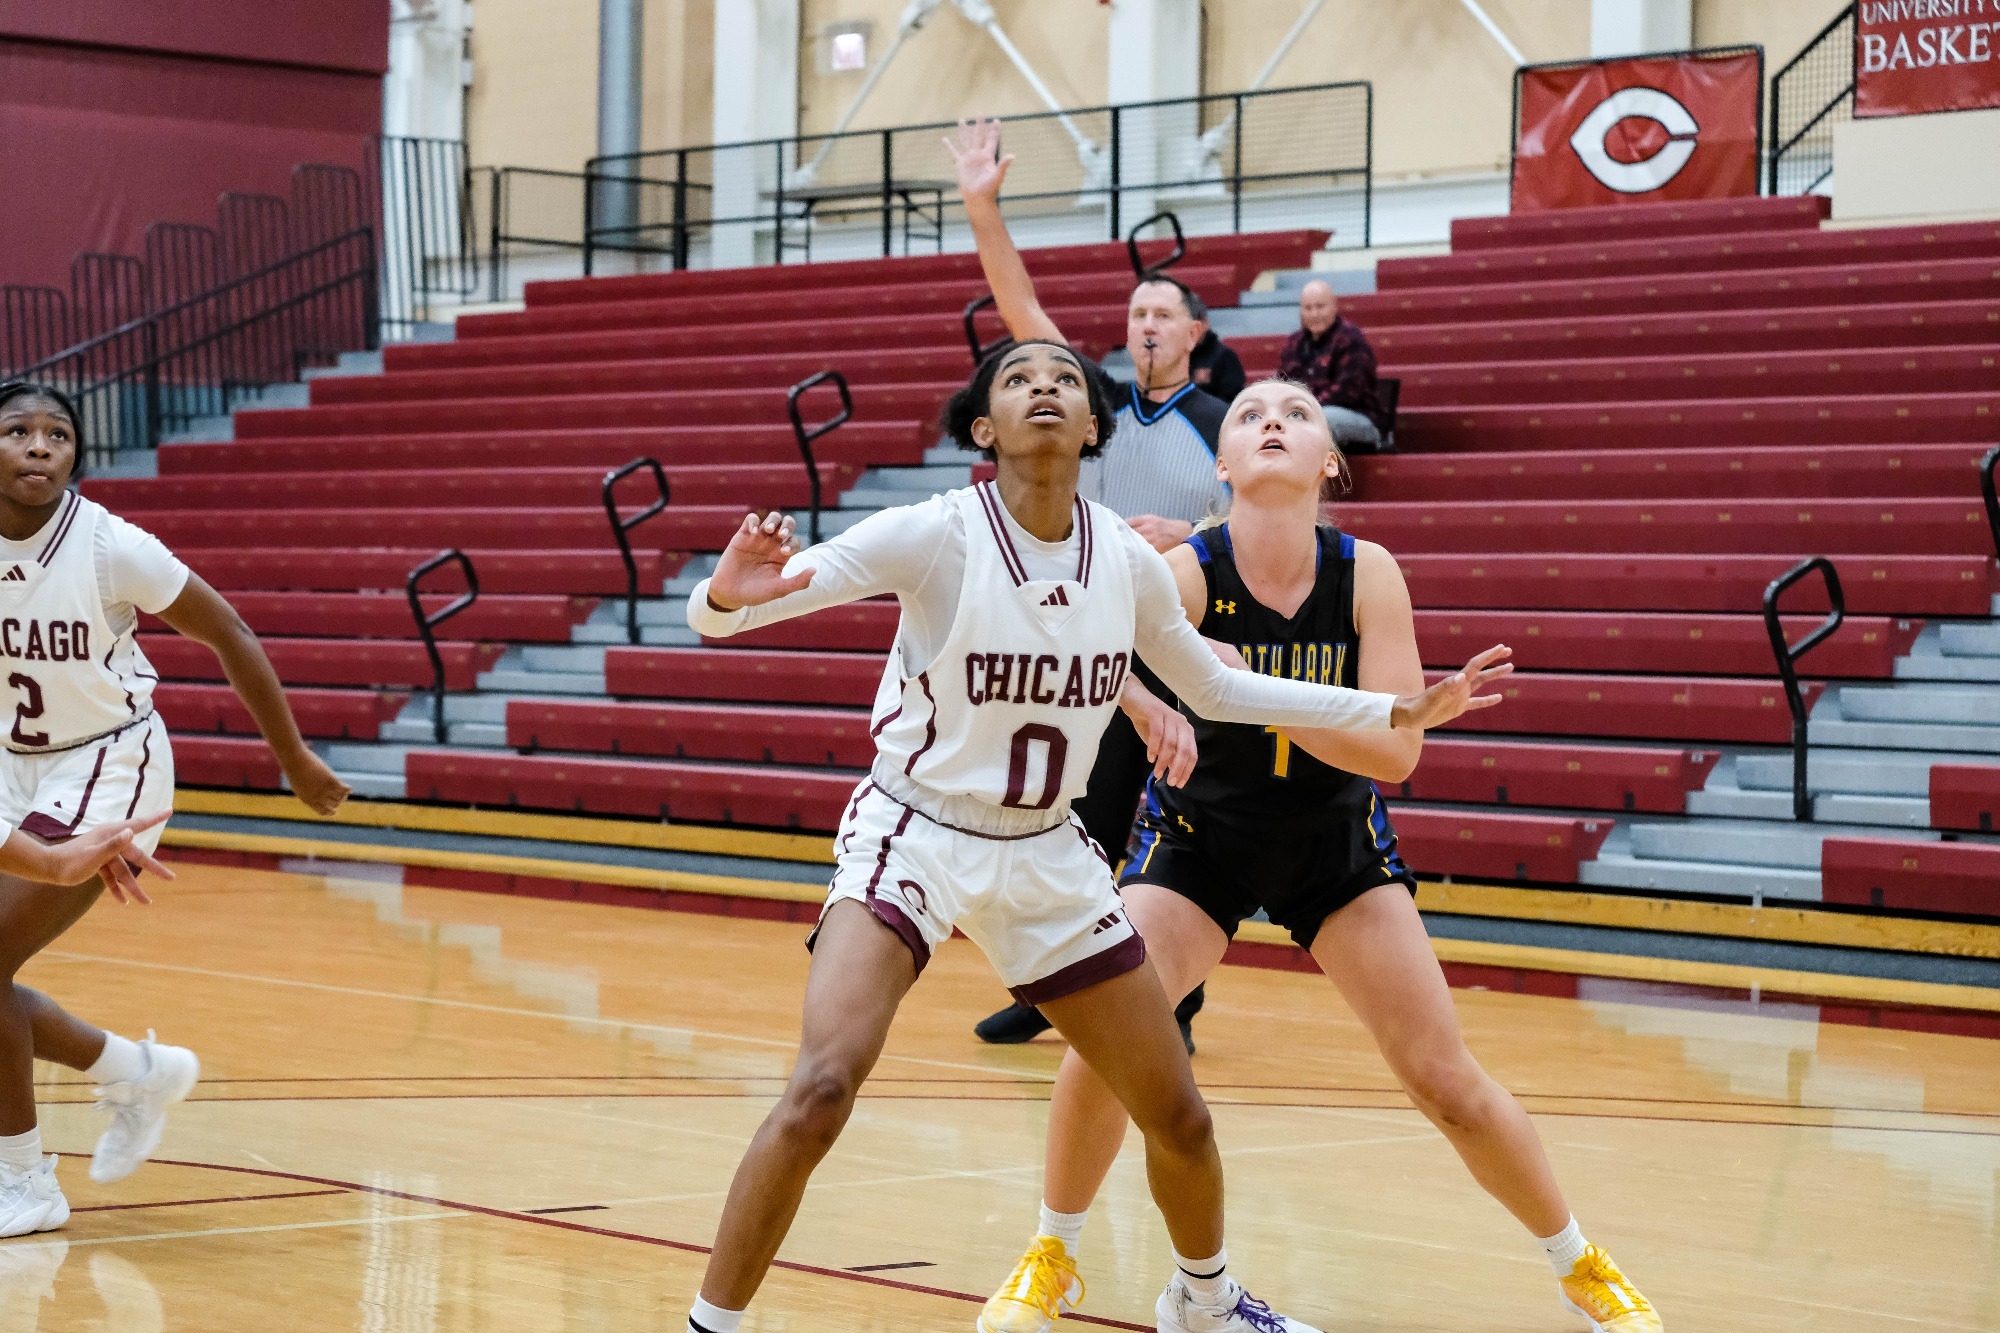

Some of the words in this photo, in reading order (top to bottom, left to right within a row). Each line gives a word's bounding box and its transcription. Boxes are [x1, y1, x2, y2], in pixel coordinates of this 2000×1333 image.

[1862, 0, 1983, 25] UNIVERSITY
[1569, 86, 1700, 195] C
[0, 618, 90, 661] CAGO
[1291, 642, 1348, 687] PARK
[966, 652, 1128, 708] CHICAGO
[8, 672, 49, 746] 2
[1001, 722, 1069, 810] 0
